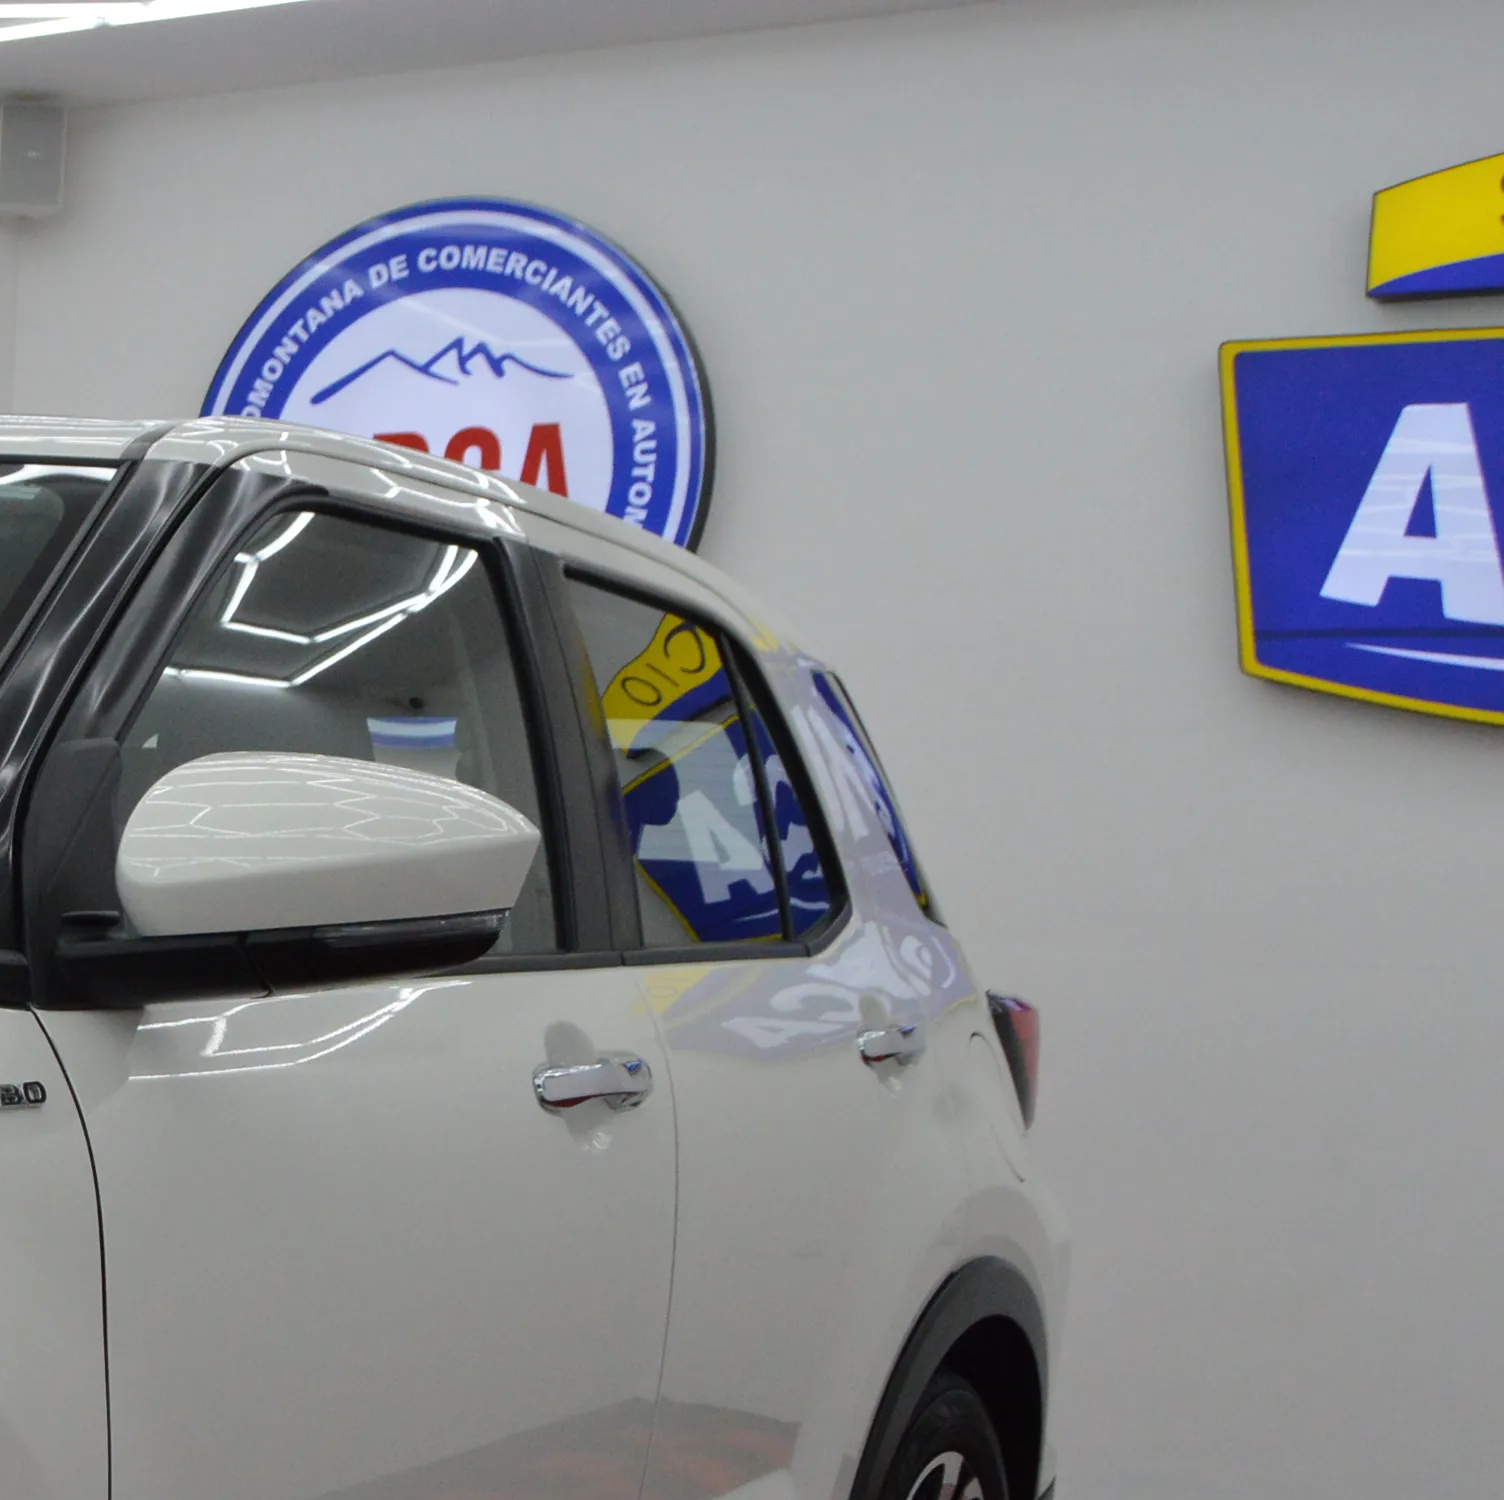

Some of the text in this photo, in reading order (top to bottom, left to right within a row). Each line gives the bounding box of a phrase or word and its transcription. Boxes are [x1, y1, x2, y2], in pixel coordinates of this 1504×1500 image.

[370, 254, 409, 289] DE
[416, 244, 630, 362] COMERCIANTES
[620, 361, 651, 412] EN
